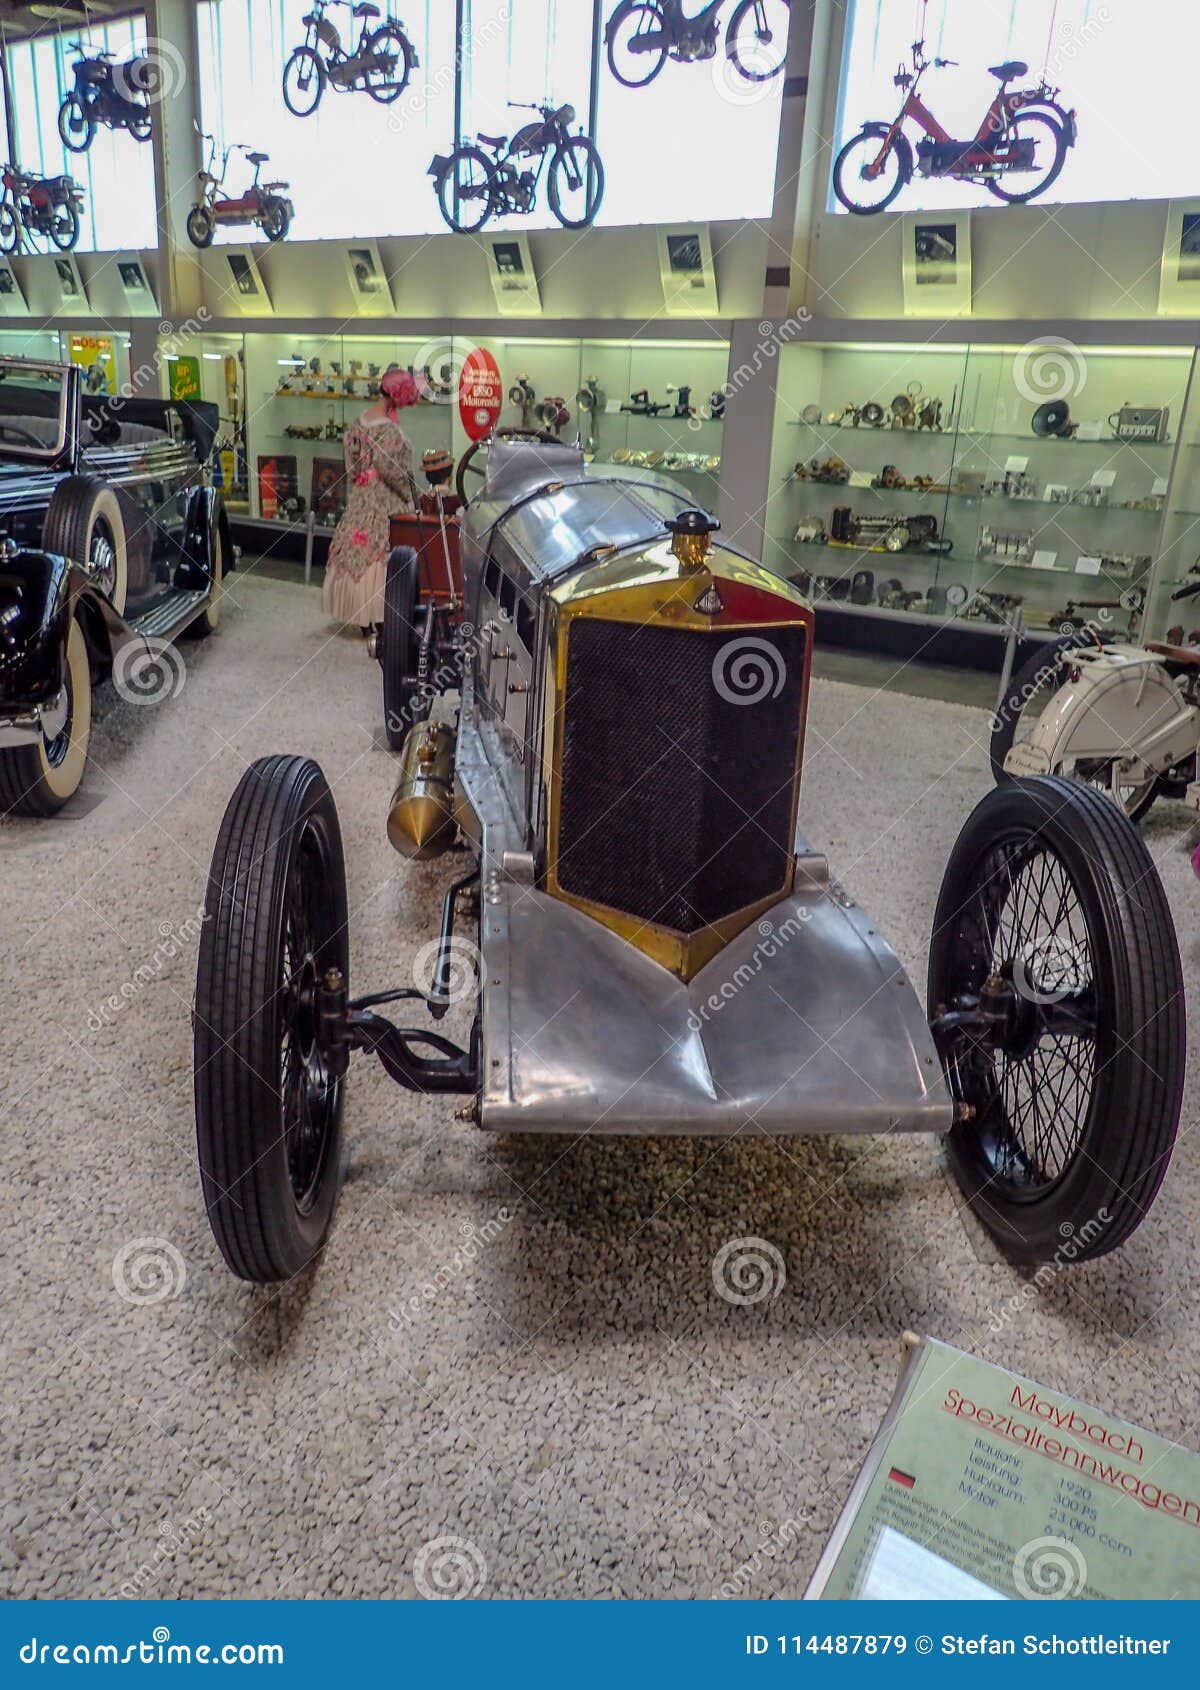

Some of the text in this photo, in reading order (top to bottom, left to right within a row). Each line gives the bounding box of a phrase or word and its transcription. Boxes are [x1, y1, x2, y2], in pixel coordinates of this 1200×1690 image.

[943, 1388, 1200, 1524] Spezialrennwagen
[1010, 1385, 1144, 1462] Maybach
[1060, 1478, 1092, 1500] 1920
